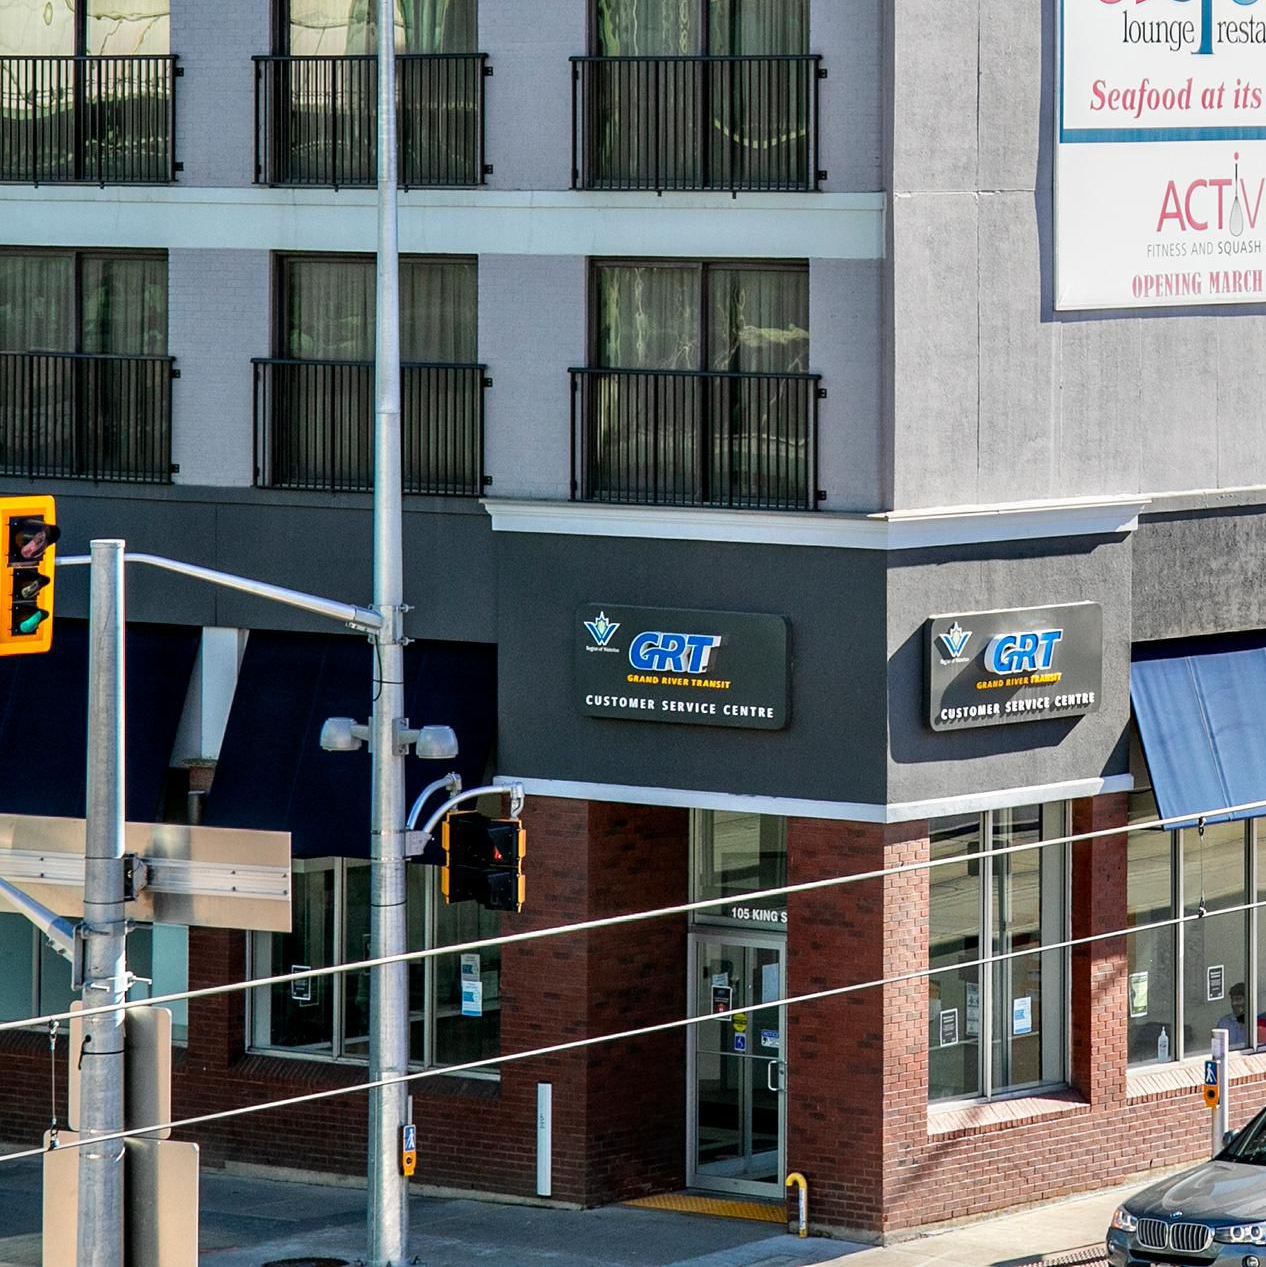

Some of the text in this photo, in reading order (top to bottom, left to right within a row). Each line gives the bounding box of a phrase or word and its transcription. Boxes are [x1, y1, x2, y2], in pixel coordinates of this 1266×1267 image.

[1122, 9, 1195, 52] lounge
[1090, 77, 1194, 119] Seafood
[1201, 81, 1227, 110] at
[1233, 78, 1263, 110] its
[1147, 241, 1188, 258] FITNESS
[1190, 241, 1214, 256] AND
[1217, 239, 1262, 256] SQUASH
[1131, 271, 1202, 299] OPENING
[1209, 268, 1264, 295] MARCH
[628, 631, 722, 674] GRT
[984, 628, 1064, 675] GRT
[627, 674, 731, 689] GRAND RIVER TRANSIT
[976, 672, 1062, 690] GRAND RIVER TRANSIT
[585, 694, 775, 719] CUSTOMER SERVICE CENTRE
[940, 691, 1095, 720] CUSTOMER SERVICE CENTRE
[732, 907, 750, 919] 105
[752, 909, 778, 922] KING
